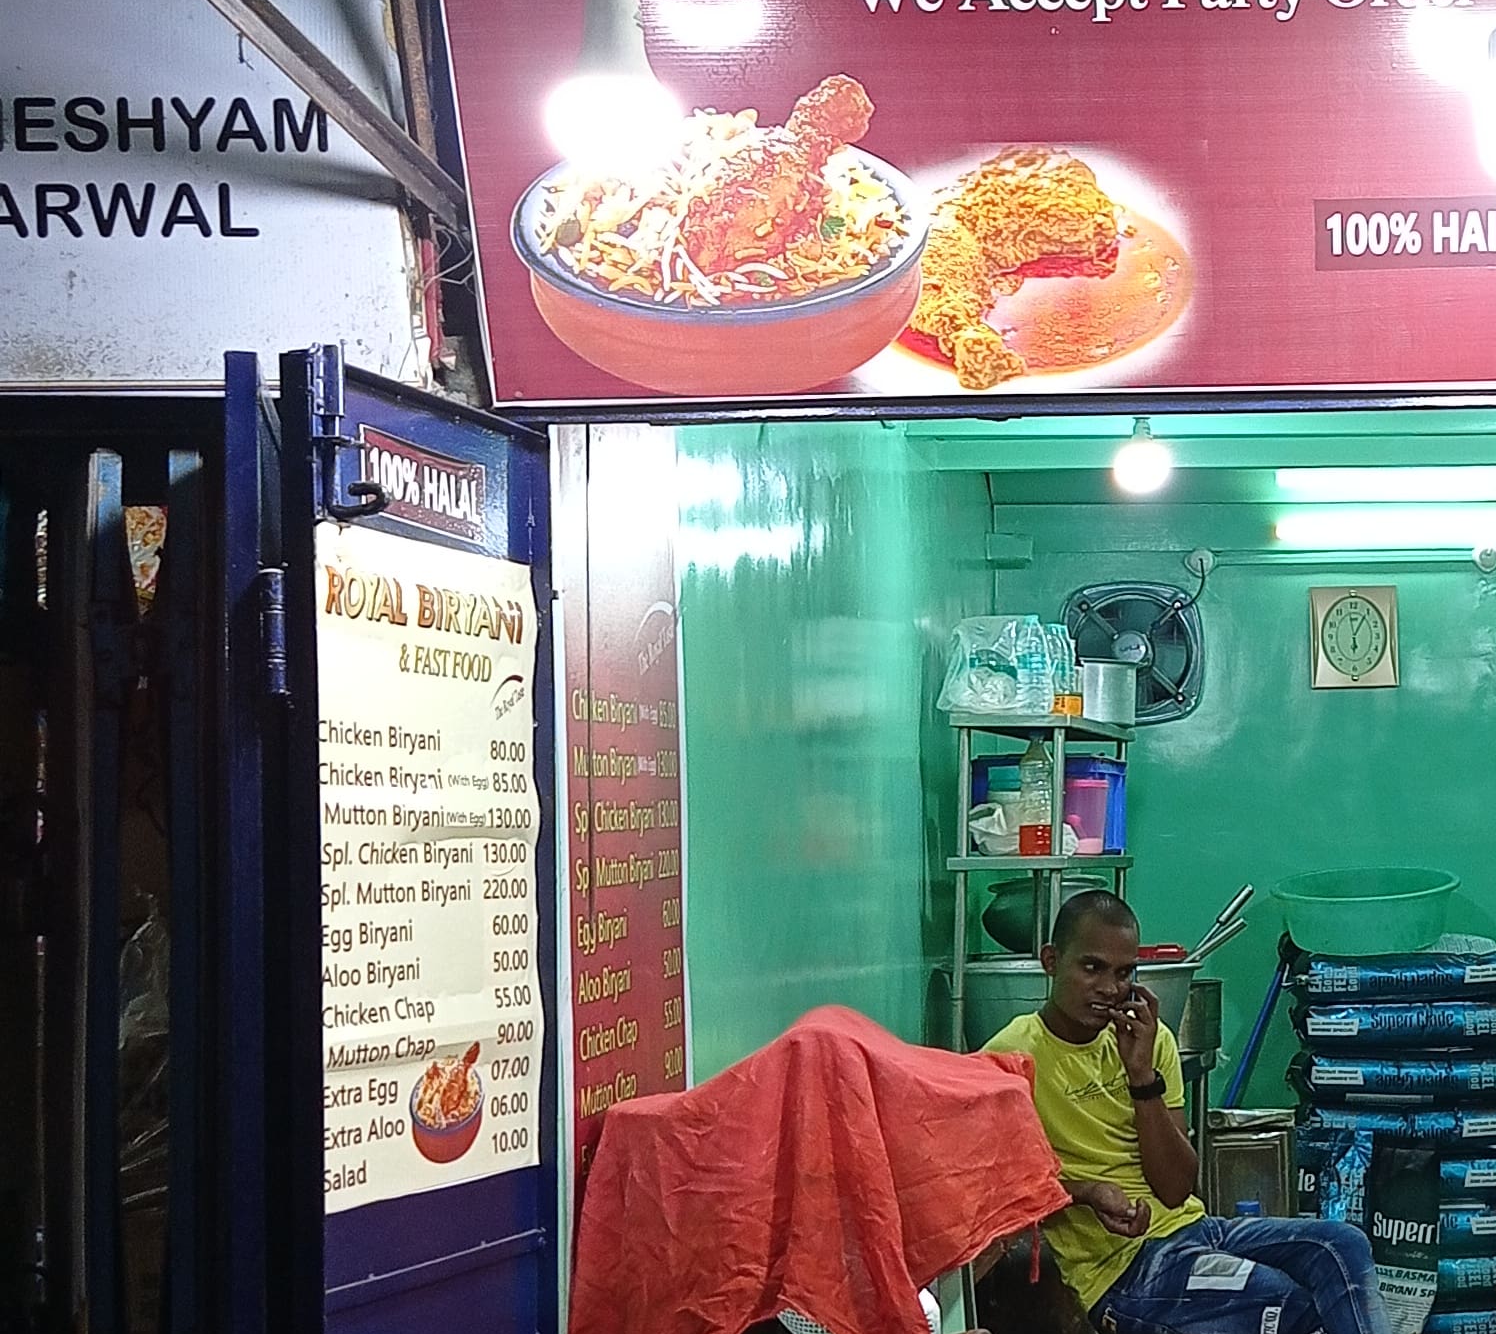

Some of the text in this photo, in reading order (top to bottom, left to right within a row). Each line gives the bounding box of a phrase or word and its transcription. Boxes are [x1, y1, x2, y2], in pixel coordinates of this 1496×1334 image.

[0, 95, 330, 154] ESHYAM
[1325, 211, 1422, 258] 100%
[422, 464, 482, 522] HALAL
[324, 565, 524, 645] ROYAL BIRYANI
[398, 643, 493, 684] & FAST FOOD
[317, 720, 526, 763] Chicken Biryani 80.00
[323, 803, 532, 833] Mutton Biryani 130.00
[321, 840, 528, 870] Spl. Chicken Biryani 130.00
[356, 881, 417, 906] Mutton
[420, 879, 472, 908] Biryani
[482, 877, 529, 901] 220.00
[321, 948, 530, 989] Aloo Biryani 50.00
[321, 984, 533, 1030] Chicken Chap 55.00
[326, 1019, 535, 1070] Mutton Chap 90.00
[321, 1055, 530, 1109] Extra Egg 07.00
[322, 1127, 530, 1193] Salad 10.00
[1372, 1210, 1436, 1246] Superr
